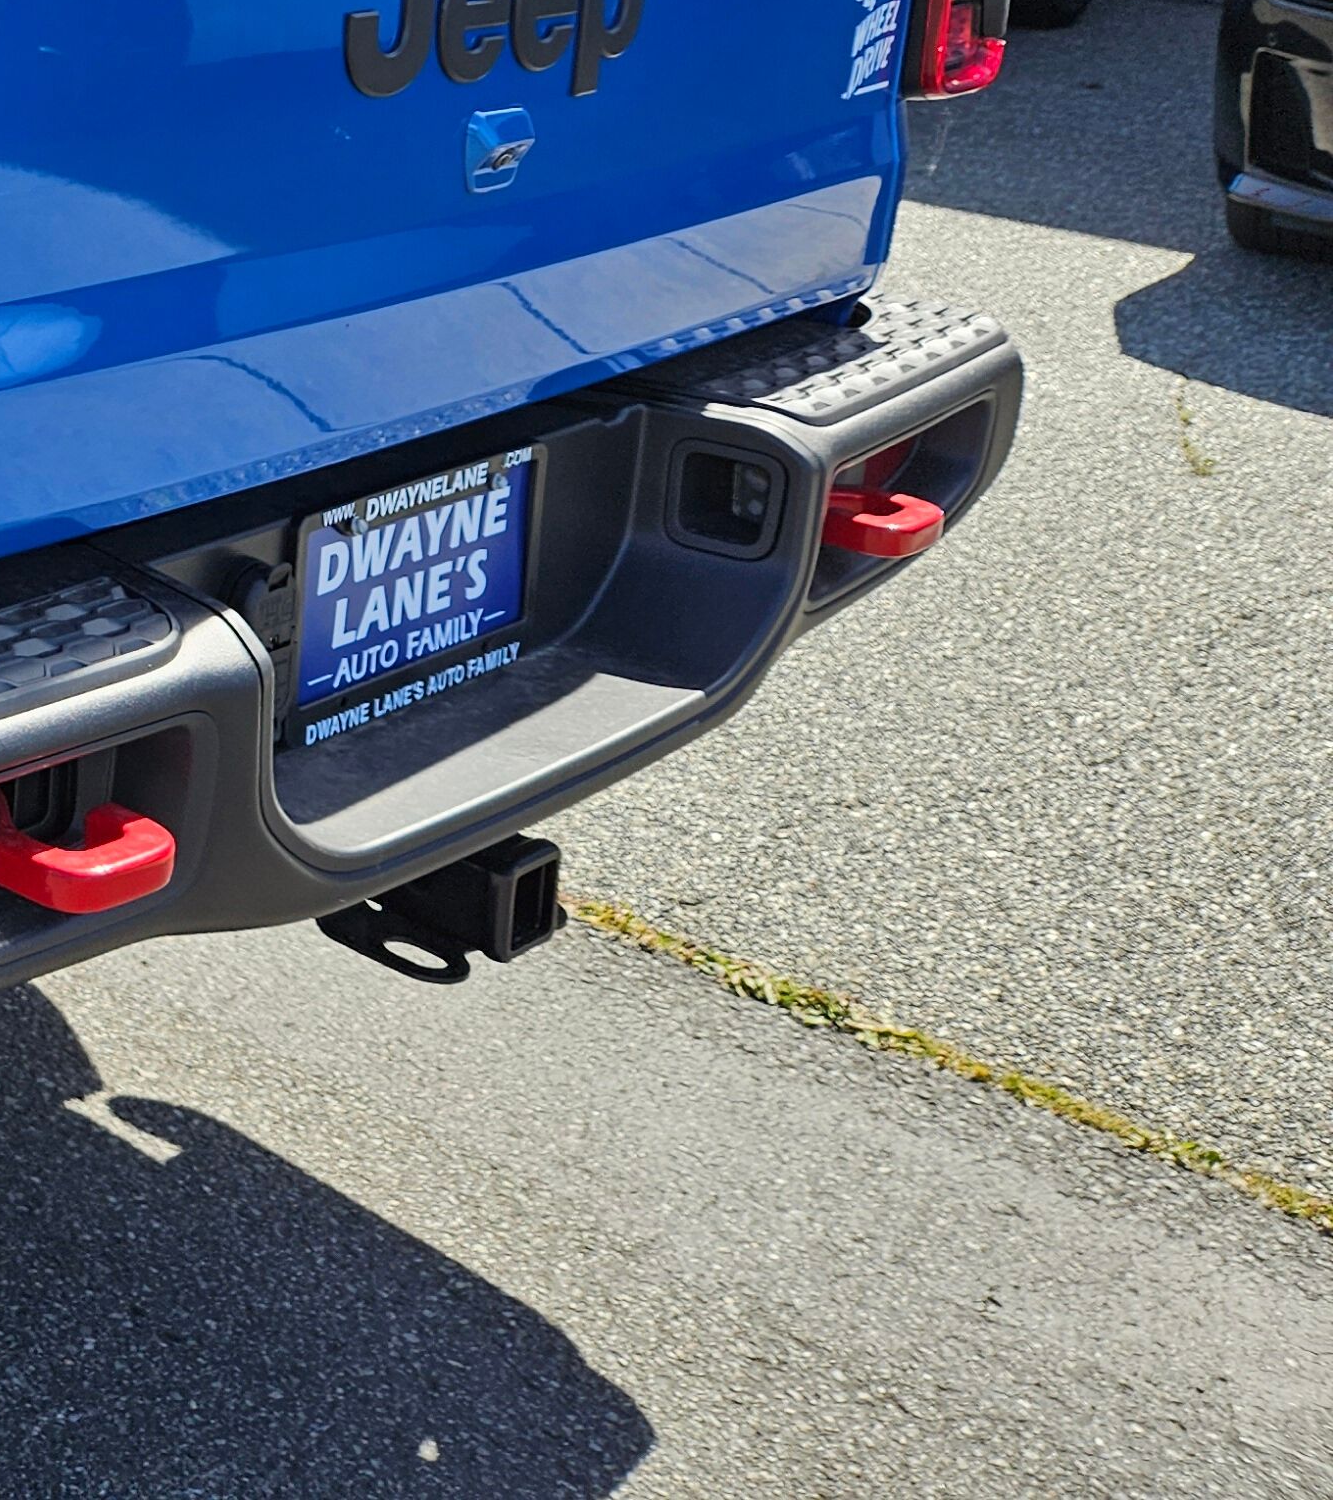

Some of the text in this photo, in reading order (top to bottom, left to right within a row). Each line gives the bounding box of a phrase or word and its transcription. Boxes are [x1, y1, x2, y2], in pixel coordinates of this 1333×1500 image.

[841, 35, 896, 100] DRIVE
[850, 0, 901, 58] WHEEL
[366, 462, 490, 522] DWAYNELANE
[316, 485, 512, 597] DWAYNE
[331, 548, 488, 650] LANE'S
[333, 608, 484, 689] AUTO FAMILY
[305, 641, 521, 746] DWAYNE LANE'S AUTO FAMILY
